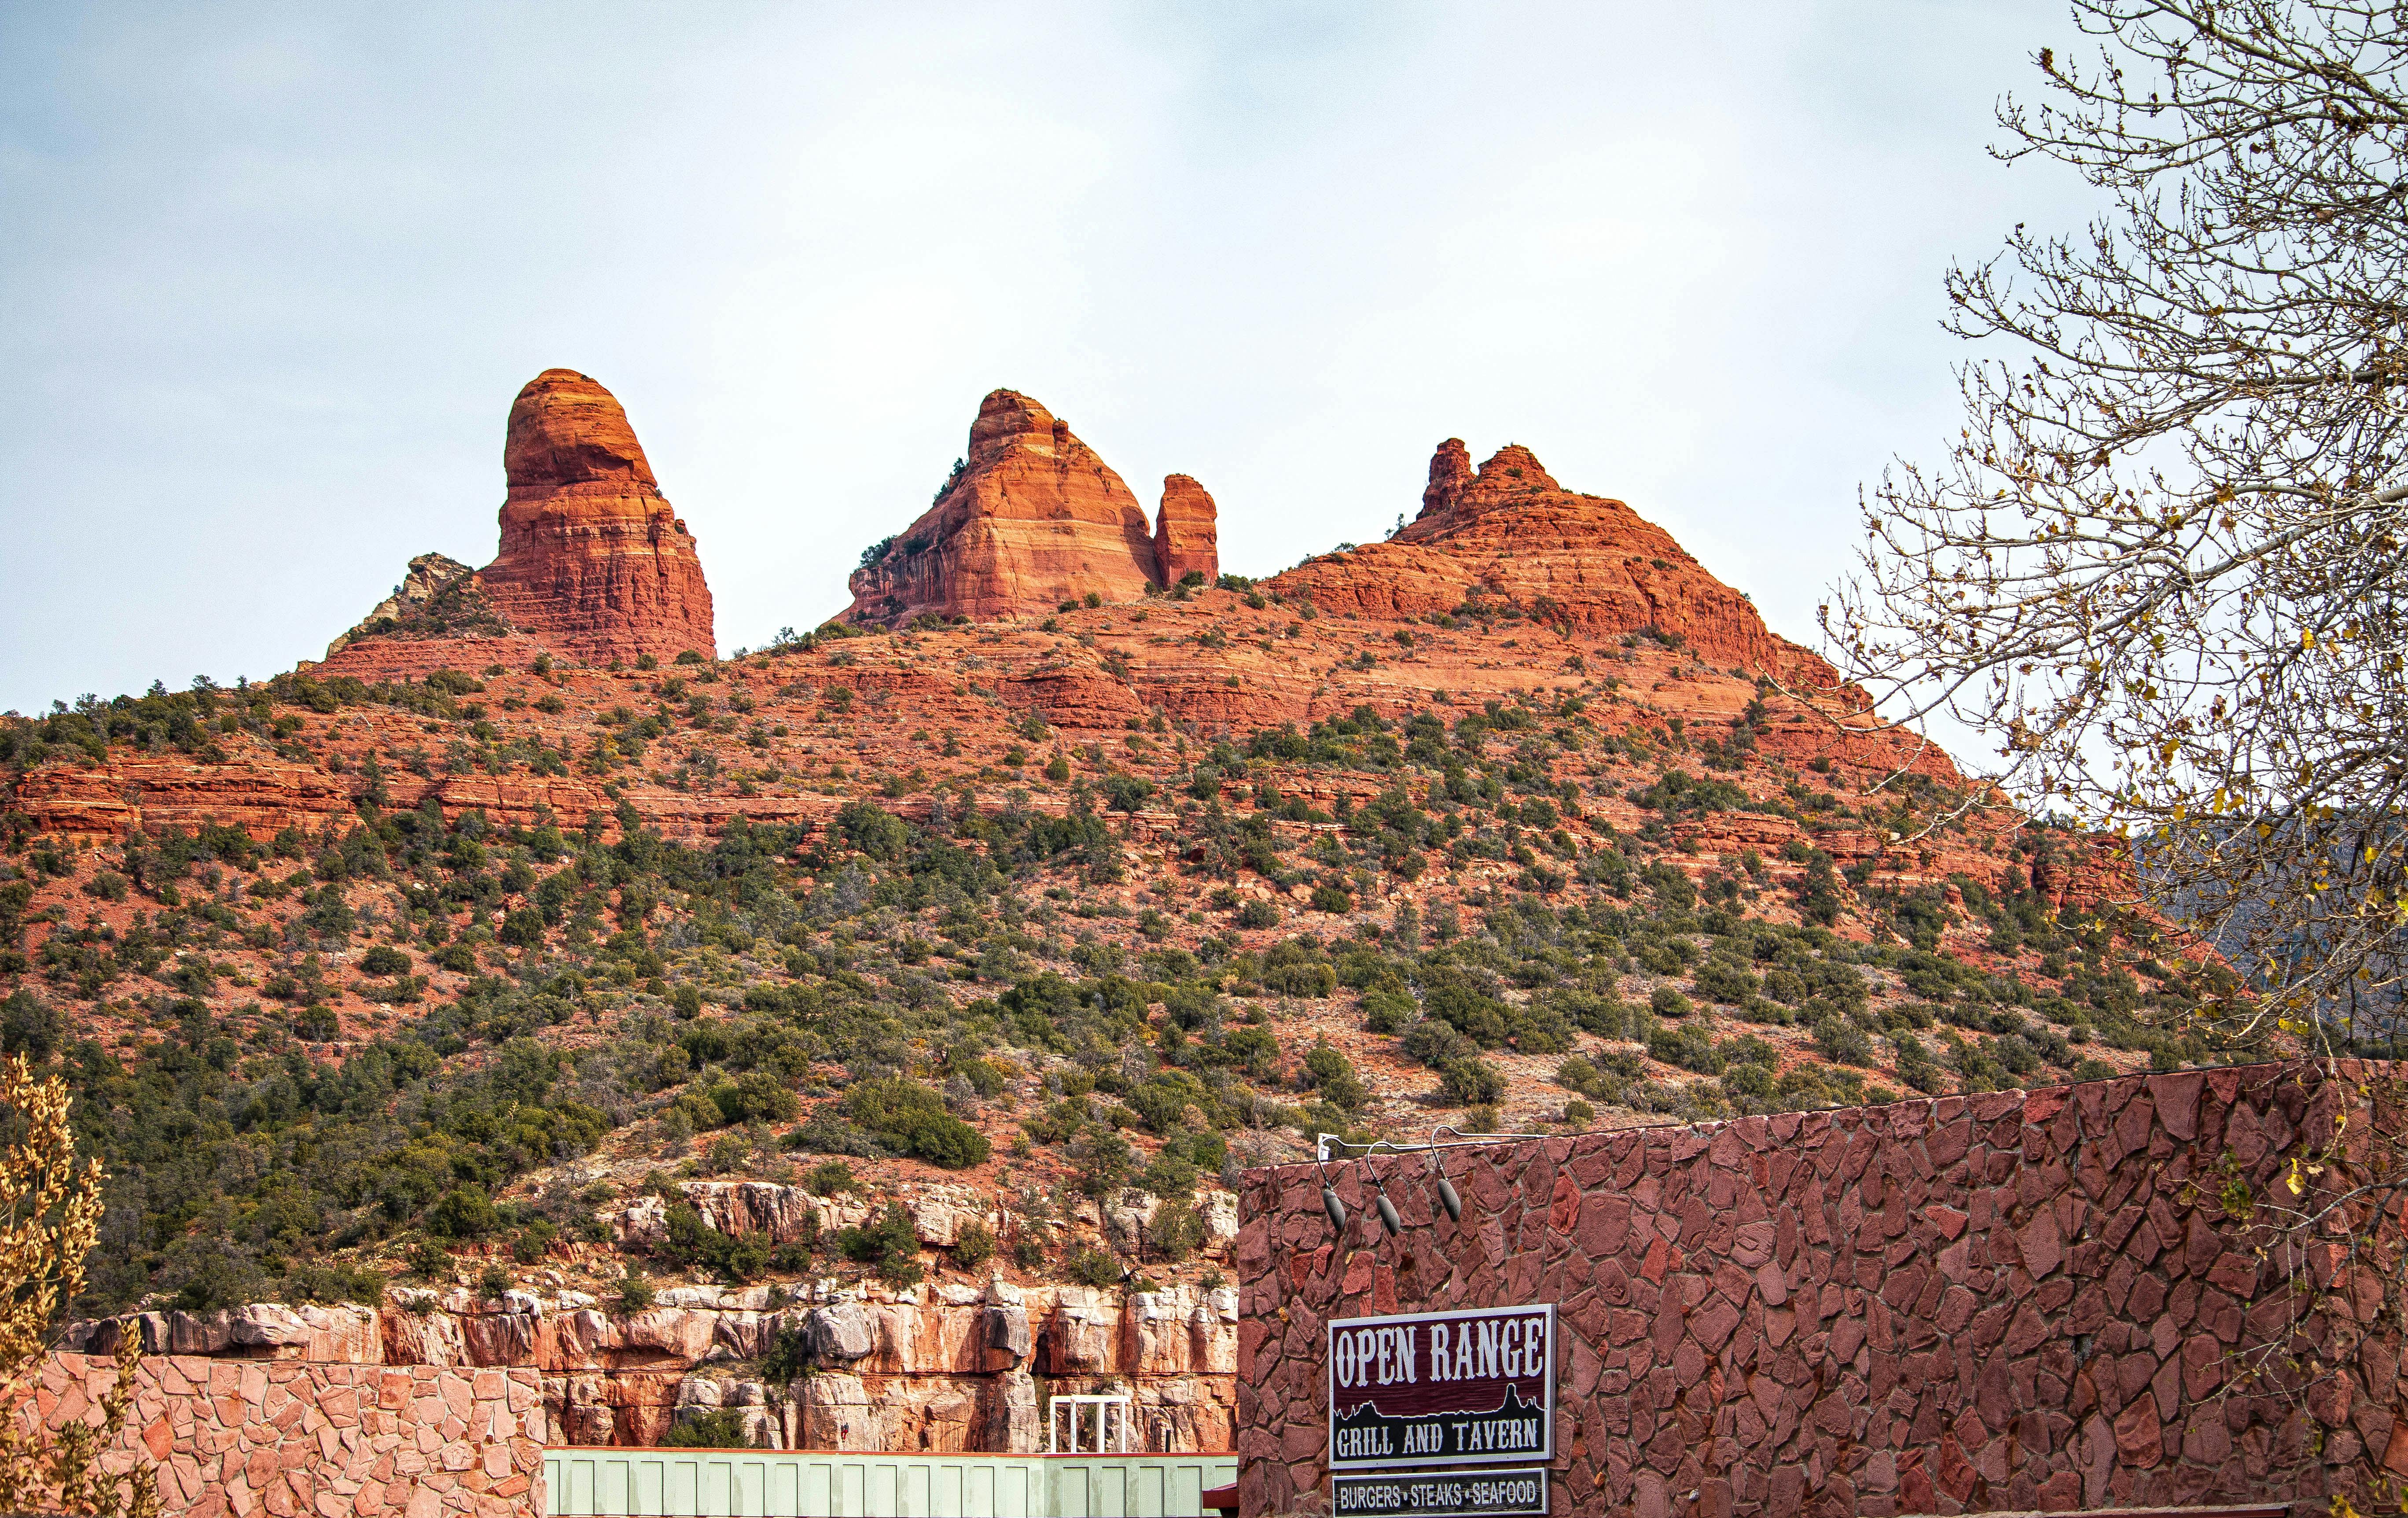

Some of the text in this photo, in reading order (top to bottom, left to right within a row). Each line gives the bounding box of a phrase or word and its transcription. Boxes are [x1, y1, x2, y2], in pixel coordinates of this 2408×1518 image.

[1336, 1318, 1543, 1387] OPEN RANGE
[1337, 1419, 1538, 1457] GRILL AND TAVERN
[1340, 1481, 1536, 1509] BURGERS STEAKS SEAFOOD
